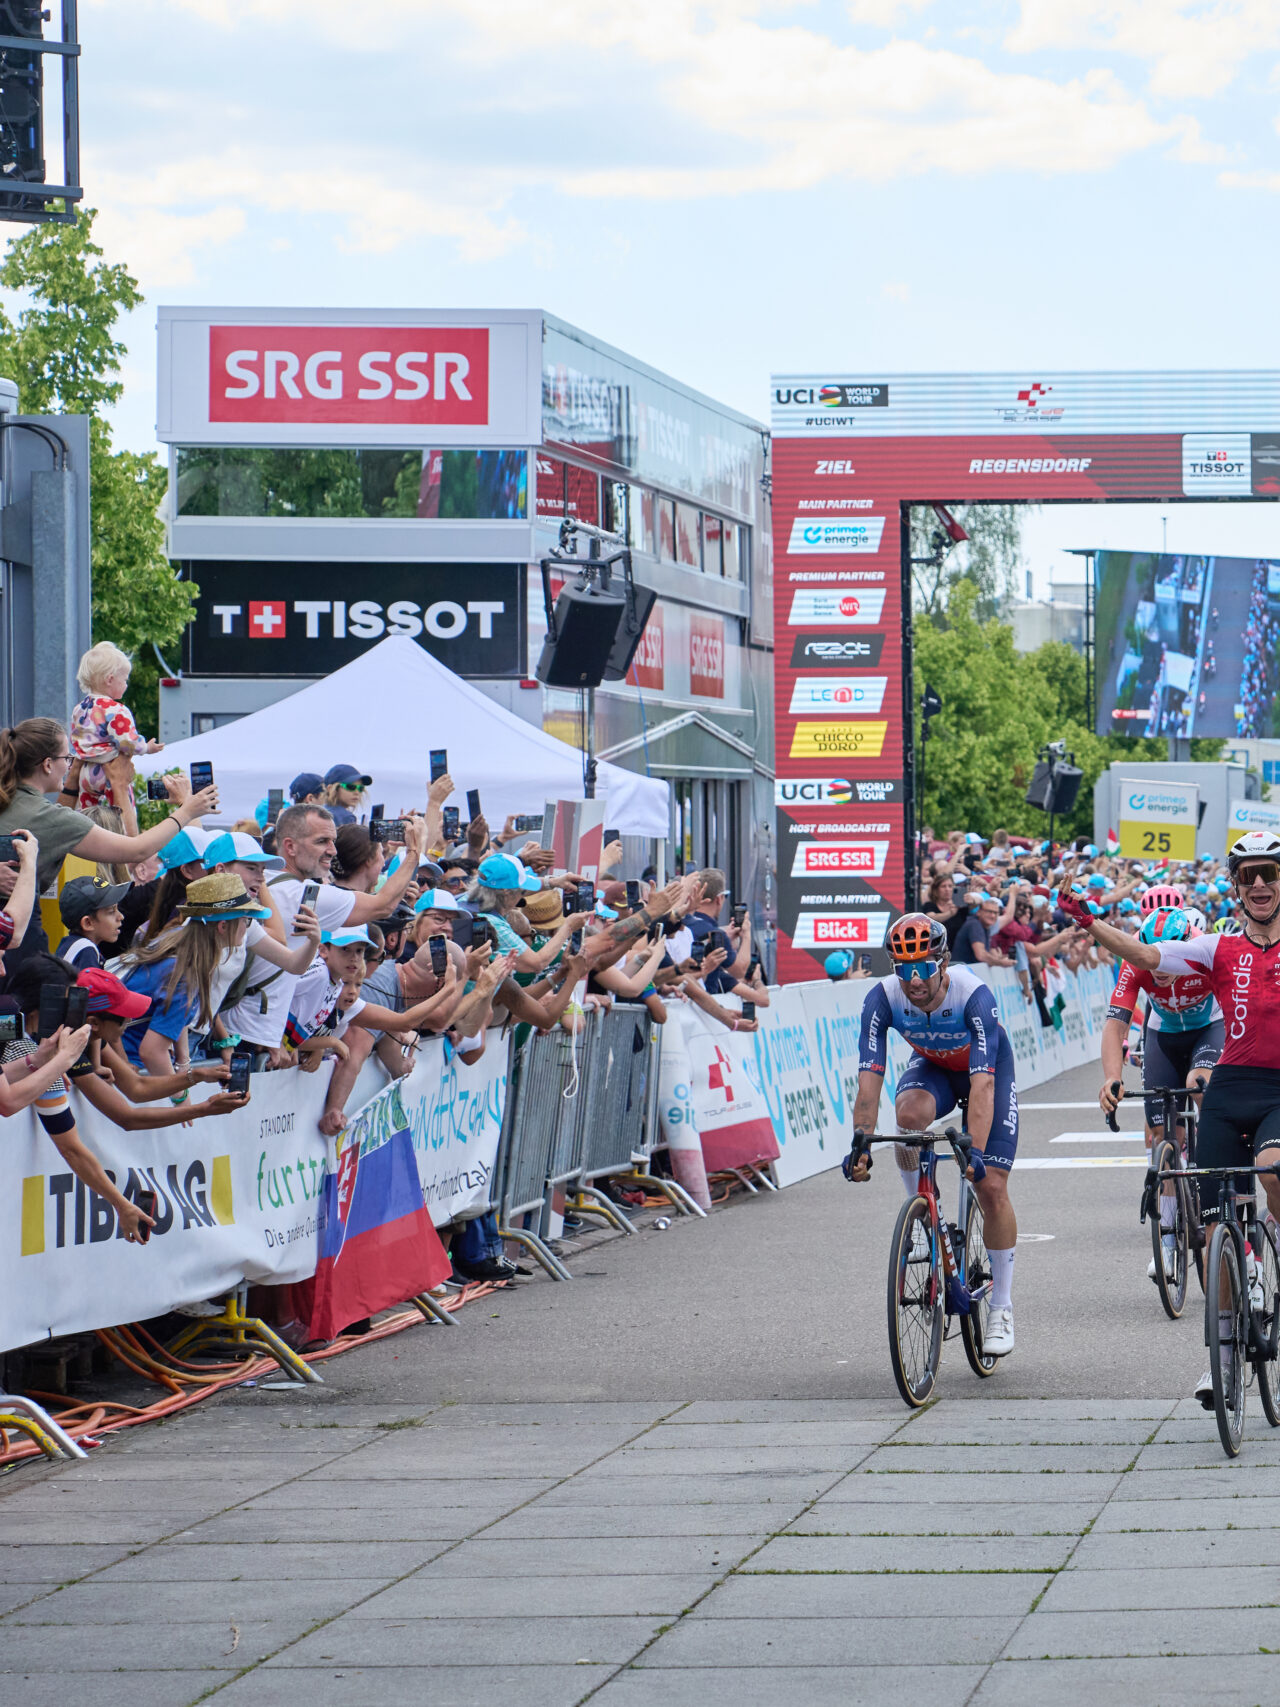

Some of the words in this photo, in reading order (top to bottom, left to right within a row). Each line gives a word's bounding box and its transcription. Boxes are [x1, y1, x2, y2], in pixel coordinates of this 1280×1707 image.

[225, 349, 342, 399] SRG
[358, 351, 472, 400] SSR
[776, 389, 814, 404] UCI
[846, 387, 880, 397] WORLD
[847, 395, 873, 405] TOUR
[805, 417, 855, 426] #UCIWT
[814, 460, 855, 474] ZIEL
[969, 458, 1092, 473] REGENSDORF
[1190, 463, 1244, 473] TISSOT
[798, 500, 825, 509] MAIN
[826, 499, 874, 509] PARTNER
[825, 526, 866, 536] primeo
[825, 534, 868, 547] energie
[789, 572, 837, 582] PREMIUM
[838, 572, 885, 581] PARTNER
[295, 601, 504, 638] TISSOT
[814, 733, 864, 742] CHICCO
[781, 784, 822, 800] UCI
[856, 783, 894, 791] WORLD
[858, 792, 886, 800] TOUR
[1148, 804, 1188, 815] energie
[789, 824, 817, 833] HOST
[817, 823, 891, 833] BROADCASTER
[1142, 831, 1171, 852] 25
[808, 852, 840, 866] SRG
[841, 852, 872, 866] SSR
[800, 895, 833, 904] MEDIA
[834, 895, 881, 904] PARTNER
[817, 922, 859, 939] Blick
[1115, 964, 1135, 998] dstny
[1231, 953, 1253, 1040] Cofidis
[868, 1011, 882, 1053] GIANT
[971, 1016, 988, 1056] GIANT
[770, 1011, 811, 1086] primeo
[785, 1070, 828, 1151] energie
[1003, 1081, 1017, 1135] Jayco
[260, 1112, 295, 1138] STANDORT
[982, 1154, 1015, 1167] CADE
[1202, 1206, 1220, 1217] CORI
[265, 1228, 285, 1248] Die
